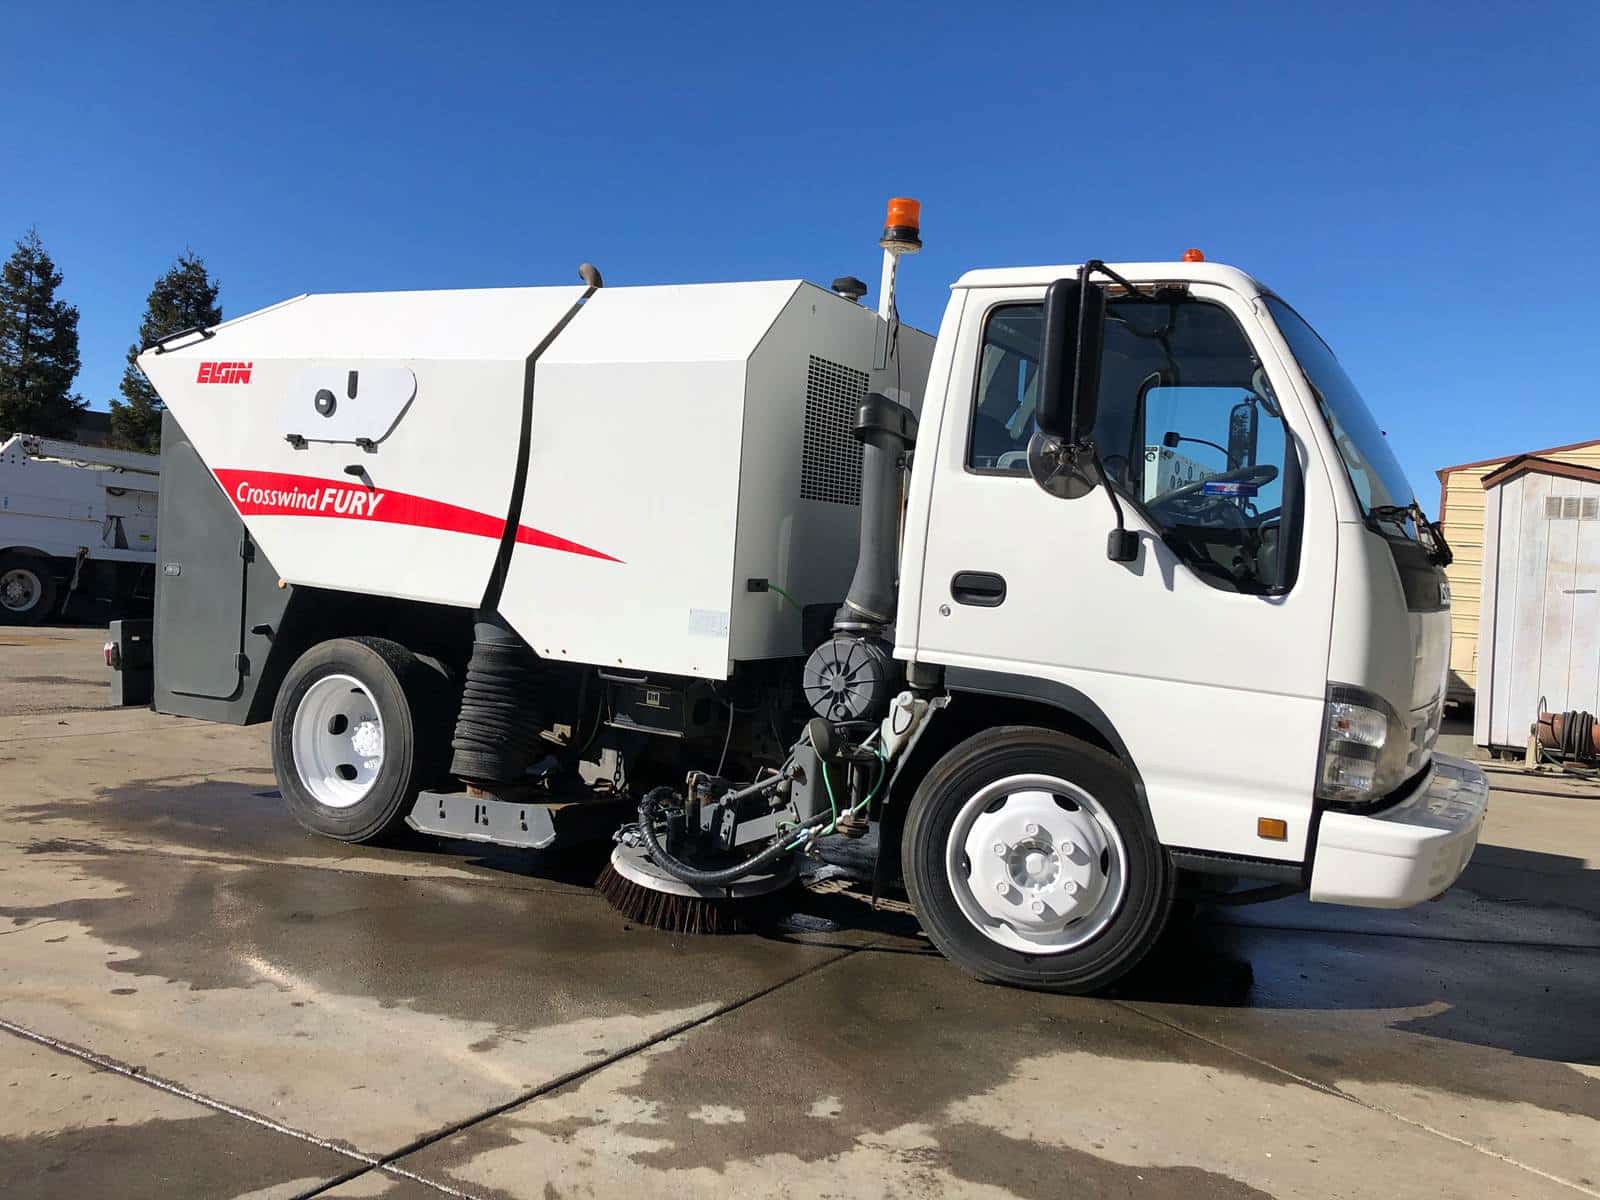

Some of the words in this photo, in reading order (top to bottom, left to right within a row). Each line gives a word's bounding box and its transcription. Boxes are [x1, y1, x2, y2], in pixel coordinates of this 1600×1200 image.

[196, 361, 253, 385] ELGIN
[236, 481, 320, 511] Crosswind
[319, 487, 385, 517] FURY
